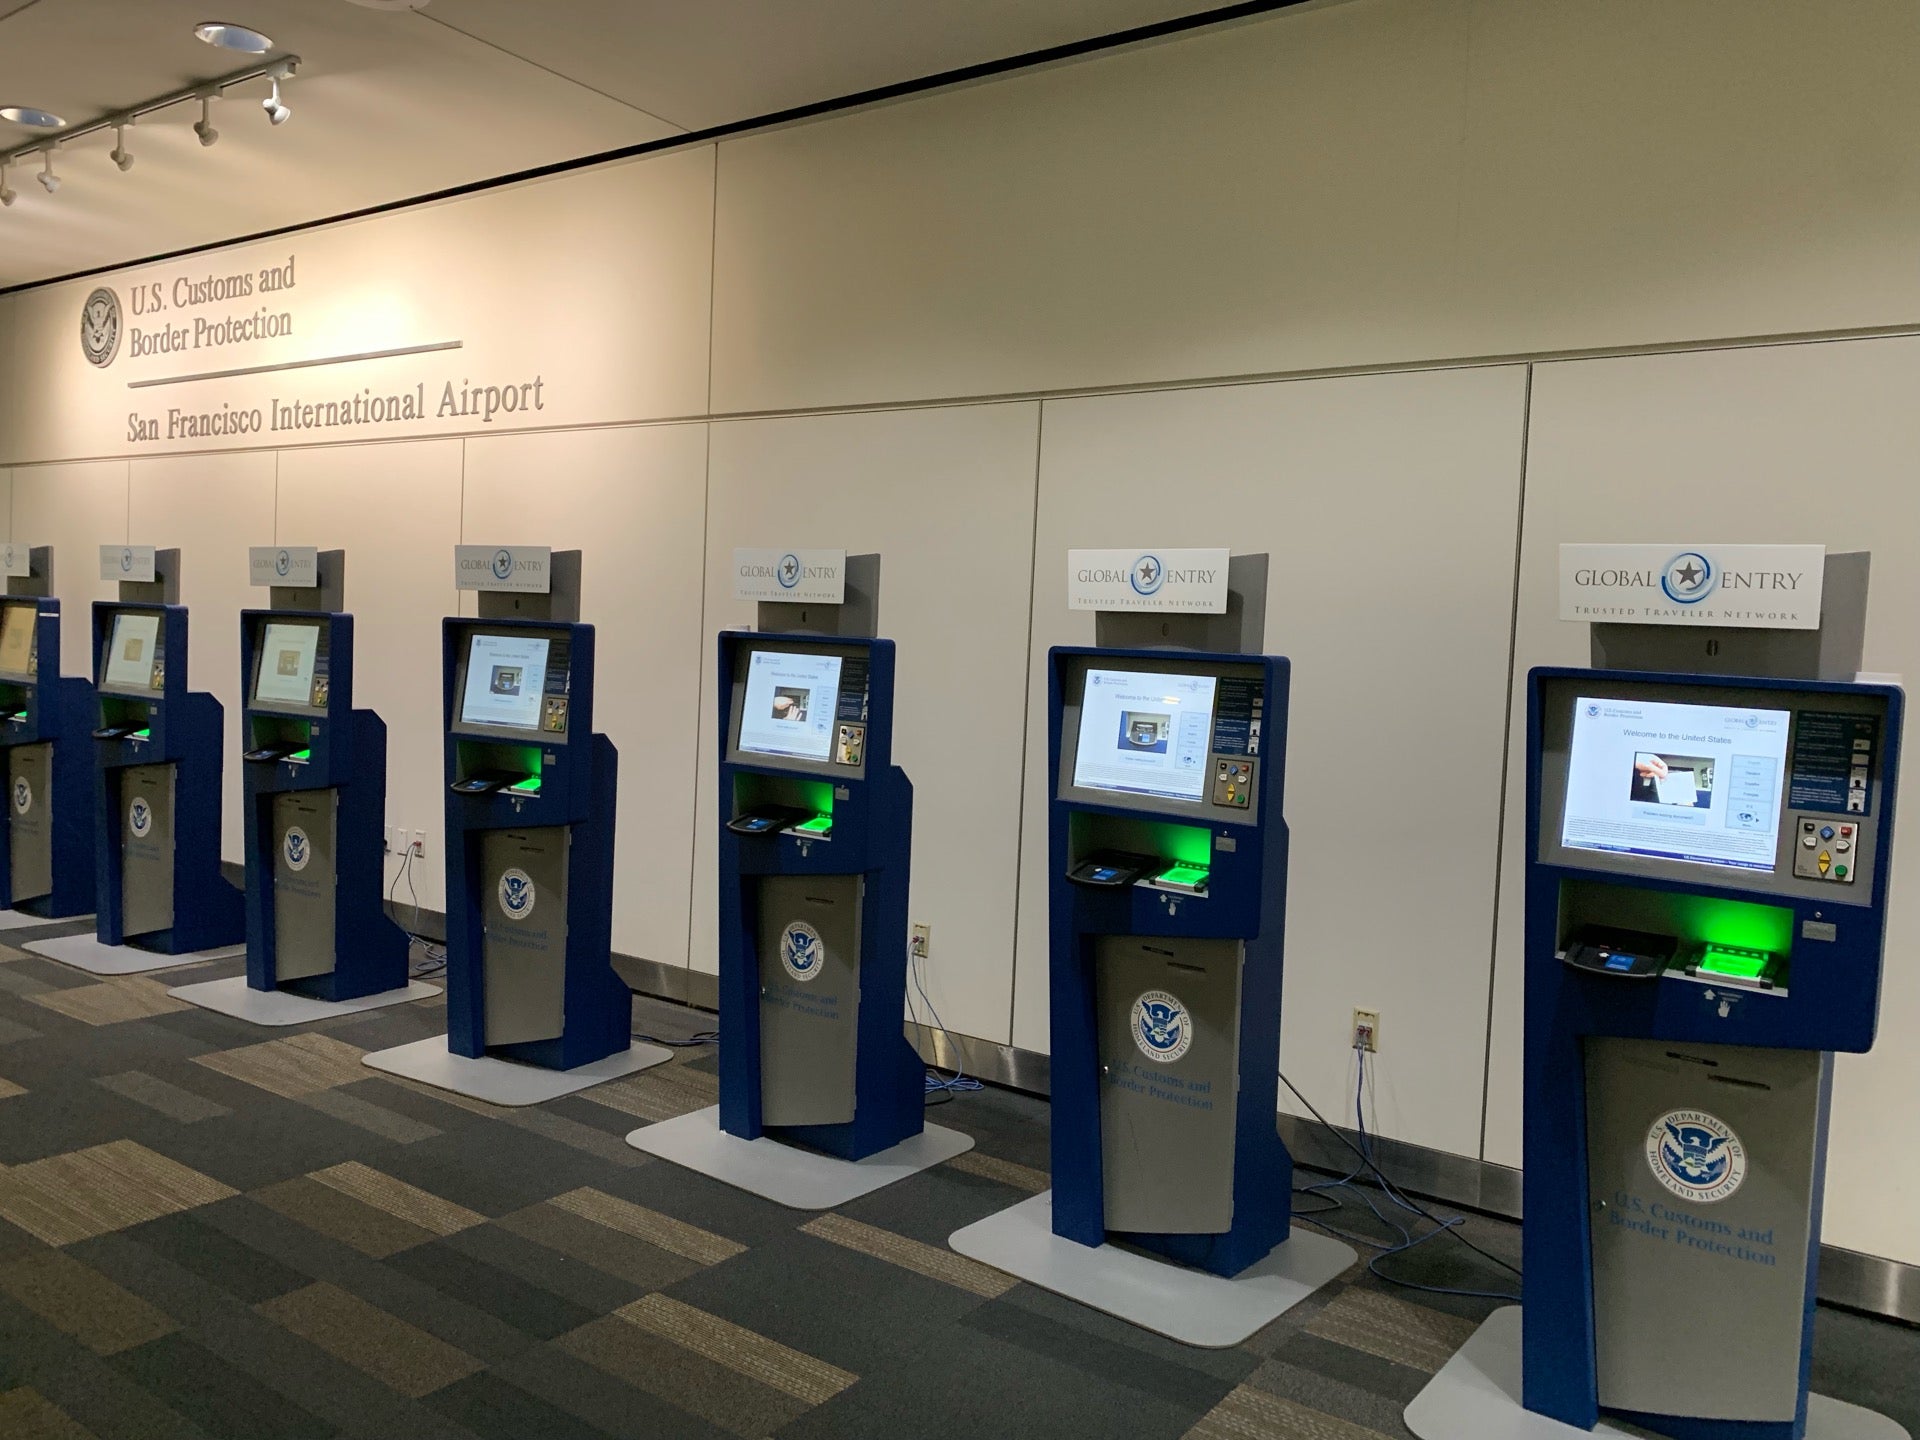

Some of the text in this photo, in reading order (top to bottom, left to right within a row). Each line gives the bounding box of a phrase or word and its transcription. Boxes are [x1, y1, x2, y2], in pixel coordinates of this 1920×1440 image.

[131, 255, 296, 316] U.S. Customs and
[129, 325, 189, 358] Border
[193, 306, 293, 349] Protection
[127, 375, 545, 442] San Francisco International Airport
[461, 559, 544, 571] GLOBAL ENTRY
[740, 565, 837, 579] GLOBAL ENTRY
[1077, 569, 1217, 584] GLOBAL ENTRY
[1574, 569, 1804, 590] GLOBAL ENTRY
[1574, 606, 1799, 621] TRUSTED TRAVELER NETWORK
[1622, 728, 1733, 745] Welcome to the United States
[1109, 1073, 1213, 1111] Border Protection
[1134, 1065, 1185, 1089] Customs
[1187, 1080, 1212, 1094] and
[1666, 1112, 1735, 1143] DEPARTMENT
[1732, 1145, 1742, 1158] OF
[1649, 1150, 1742, 1200] HOMELAND SECURITY
[1614, 1190, 1774, 1246] U.S. Customs and
[1609, 1209, 1777, 1267] Border Protection
